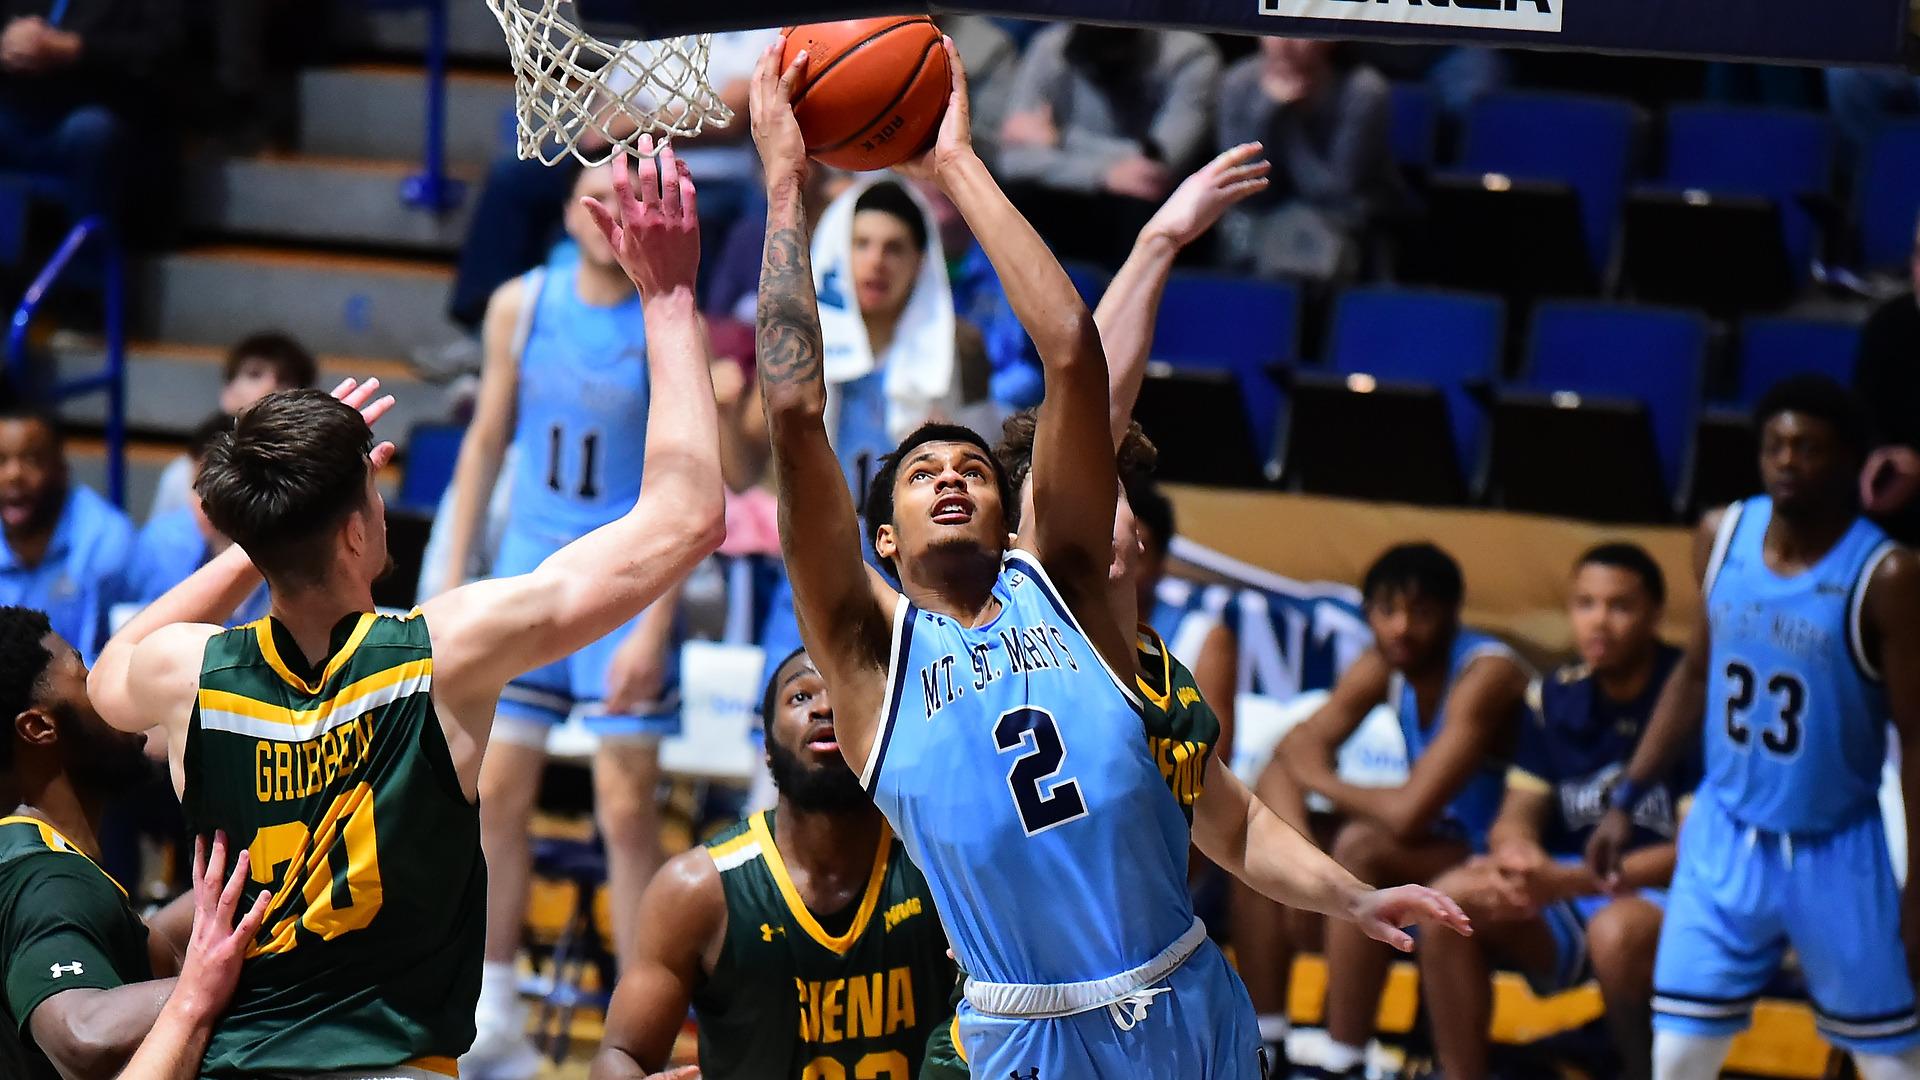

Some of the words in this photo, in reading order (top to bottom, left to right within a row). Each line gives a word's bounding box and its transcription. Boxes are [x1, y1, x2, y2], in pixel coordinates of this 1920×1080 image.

[547, 422, 600, 499] 11
[921, 654, 964, 721] MT.
[971, 642, 1003, 691] ST.
[999, 620, 1080, 674] MRY'S
[1725, 660, 1807, 758] 23
[256, 712, 375, 802] GRIBBEN
[991, 704, 1089, 838] 2
[243, 780, 383, 959] 20
